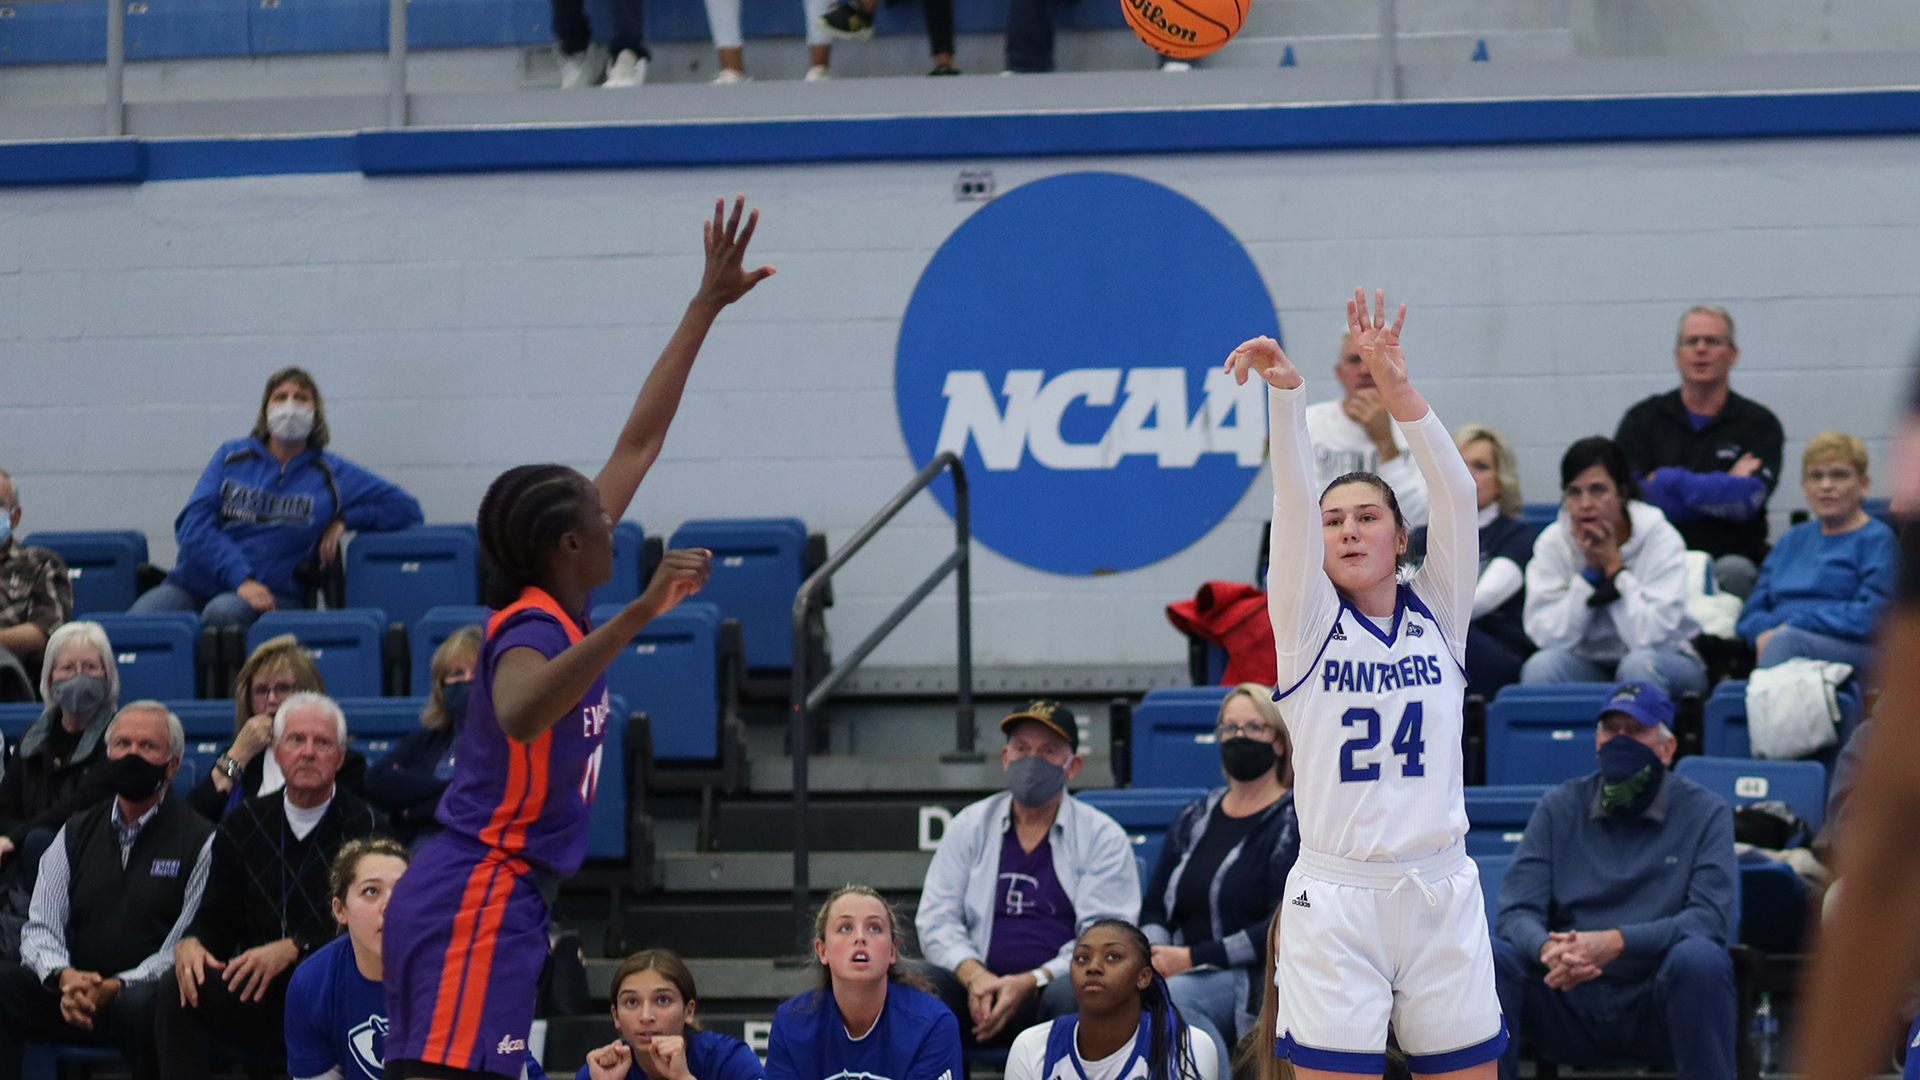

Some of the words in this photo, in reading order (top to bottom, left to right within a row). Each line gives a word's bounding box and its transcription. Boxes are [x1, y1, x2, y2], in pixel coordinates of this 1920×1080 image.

[934, 366, 1267, 471] NCAA
[1322, 655, 1443, 694] PANTHERS
[1339, 700, 1426, 784] 24
